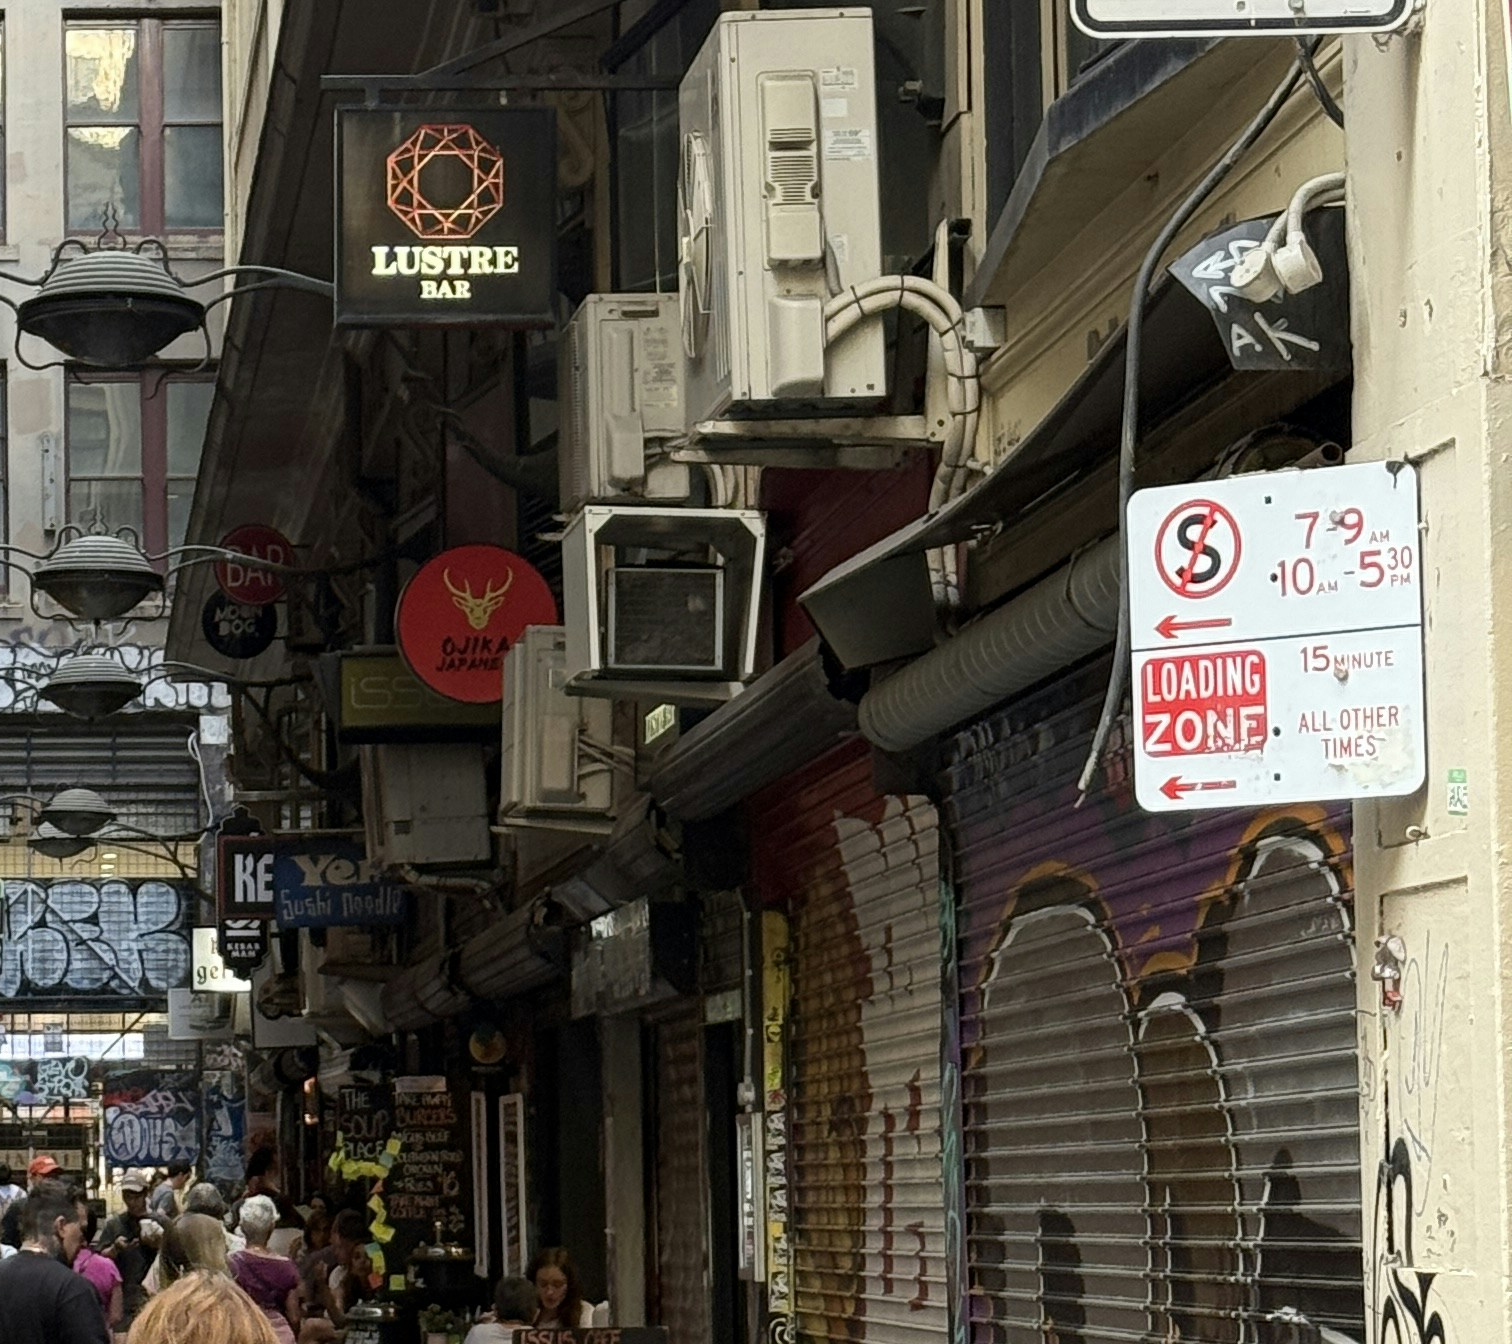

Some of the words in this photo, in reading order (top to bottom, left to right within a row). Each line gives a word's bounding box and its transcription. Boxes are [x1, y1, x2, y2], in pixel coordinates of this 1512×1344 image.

[371, 245, 519, 275] LUSTRE
[420, 279, 471, 299] BAR
[1369, 530, 1390, 544] AM
[1277, 558, 1315, 597] 10
[1316, 579, 1338, 594] AM
[1390, 574, 1411, 587] PM
[1299, 645, 1330, 673] 15
[1333, 649, 1395, 670] MINUTE
[1145, 654, 1261, 703] LOADING
[1144, 705, 1266, 754] ZONE
[1299, 709, 1331, 734] ALL
[1339, 706, 1399, 729] OTHER
[1321, 735, 1377, 759] TIMES
[280, 887, 333, 921] Sushi
[340, 1088, 370, 1110] THE
[341, 1109, 391, 1138] SOUP
[342, 1139, 384, 1159] PLACE
